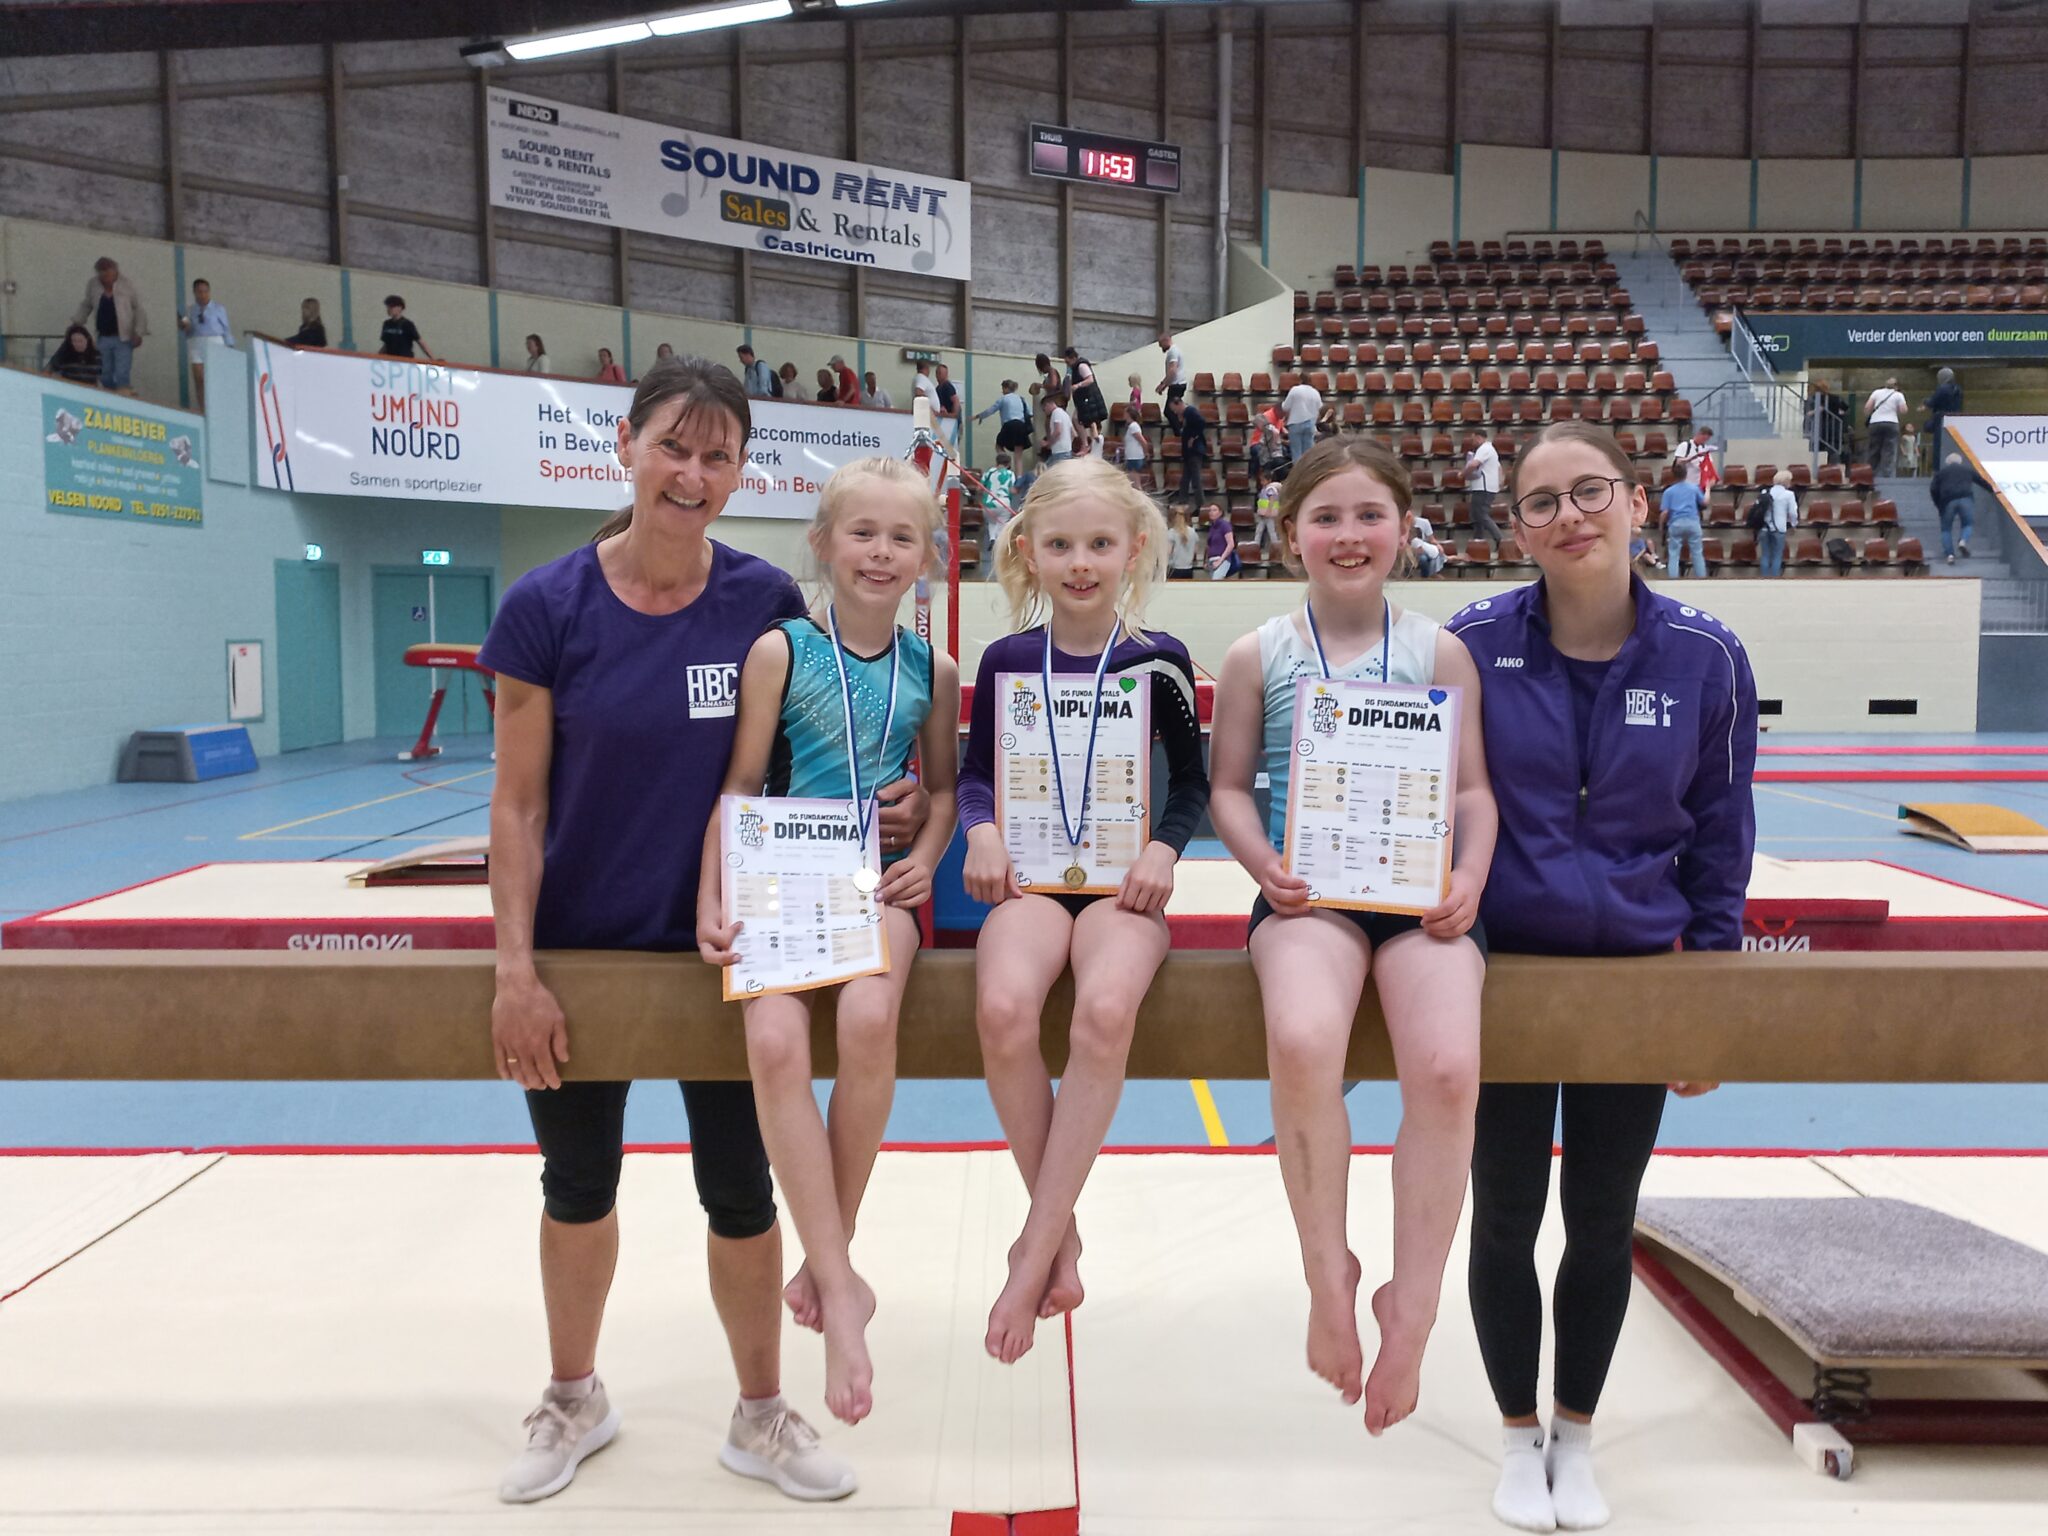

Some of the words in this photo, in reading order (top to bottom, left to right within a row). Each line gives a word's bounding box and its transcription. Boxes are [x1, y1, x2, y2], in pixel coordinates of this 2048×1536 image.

[1040, 132, 1062, 142] THUIS
[519, 139, 560, 157] SOUND
[564, 148, 594, 163] RENT
[1148, 148, 1177, 159] GASTEN
[501, 148, 540, 165] SALES
[544, 156, 553, 168] &
[558, 159, 611, 179] RENTALS
[1087, 151, 1133, 180] 11:53
[660, 139, 821, 196] SOUND
[832, 171, 947, 216] RENT
[510, 185, 554, 200] TELEFOON
[725, 194, 787, 227] Sales
[797, 208, 821, 232] &
[833, 213, 922, 248] Rentals
[764, 235, 876, 264] Castricum
[1848, 329, 1886, 343] Verder
[1888, 329, 1932, 342] denken
[1934, 331, 1958, 342] voor
[1962, 331, 1984, 342] een
[1988, 329, 2048, 342] duurzaam
[370, 360, 459, 400] SPORT
[84, 407, 167, 442] ZAANBEVER
[538, 403, 572, 423] Het
[750, 426, 881, 448] accommodaties
[372, 421, 461, 461] NOORD
[539, 430, 557, 449] in
[349, 471, 401, 488] Samen
[404, 477, 483, 493] sportplezier
[773, 475, 788, 492] in
[48, 489, 86, 508] VELSEN
[1494, 656, 1525, 668] JAKO
[686, 668, 738, 702] HBC
[688, 699, 736, 709] GYMNASTICS
[1377, 700, 1429, 709] FUNDAMENTALS
[1625, 692, 1657, 715] HBC
[1348, 707, 1442, 732] DIPLOMA
[800, 813, 848, 821] FUNDAMENTALS
[774, 822, 860, 841] DIPLOMA
[287, 934, 414, 951] GYMNOVA
